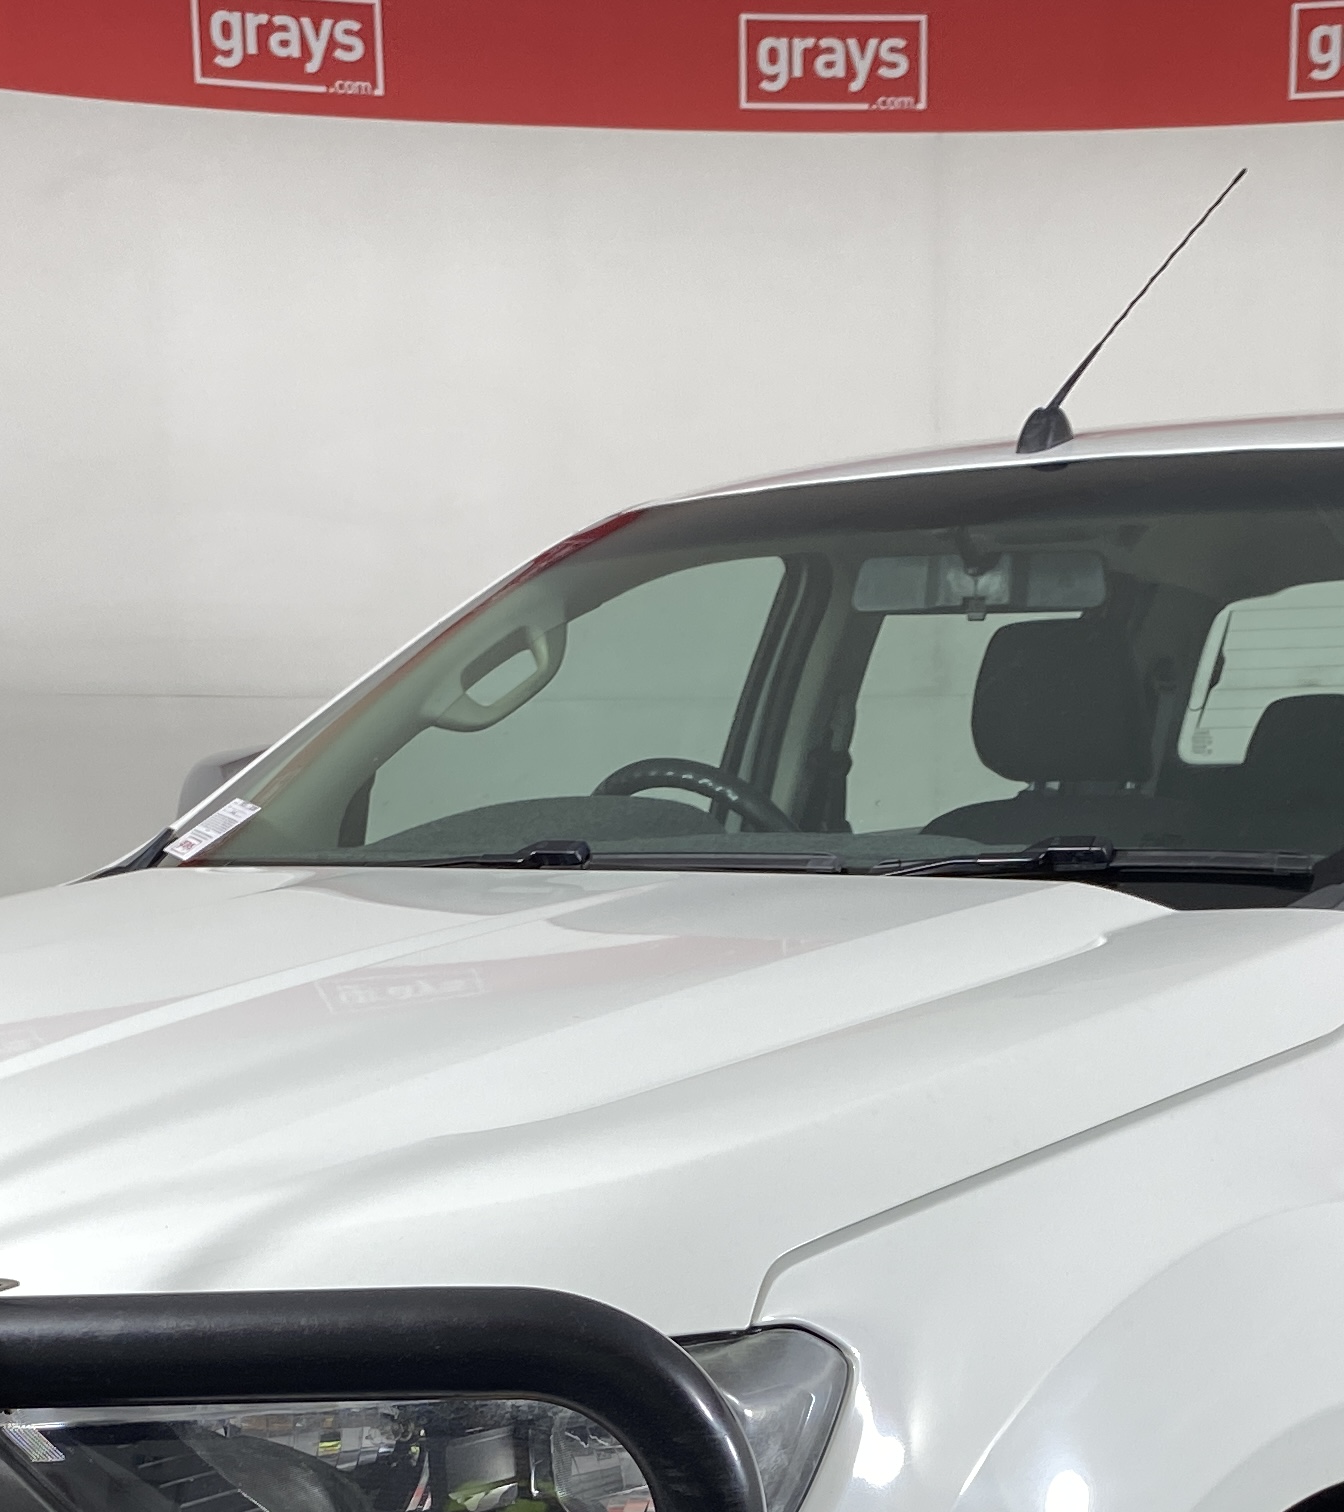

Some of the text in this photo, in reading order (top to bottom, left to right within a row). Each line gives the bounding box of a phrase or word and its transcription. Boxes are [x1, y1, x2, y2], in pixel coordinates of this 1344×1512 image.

[209, 10, 366, 74] grays
[757, 36, 911, 93] grays
[328, 80, 373, 95] .com
[868, 96, 916, 111] .com
